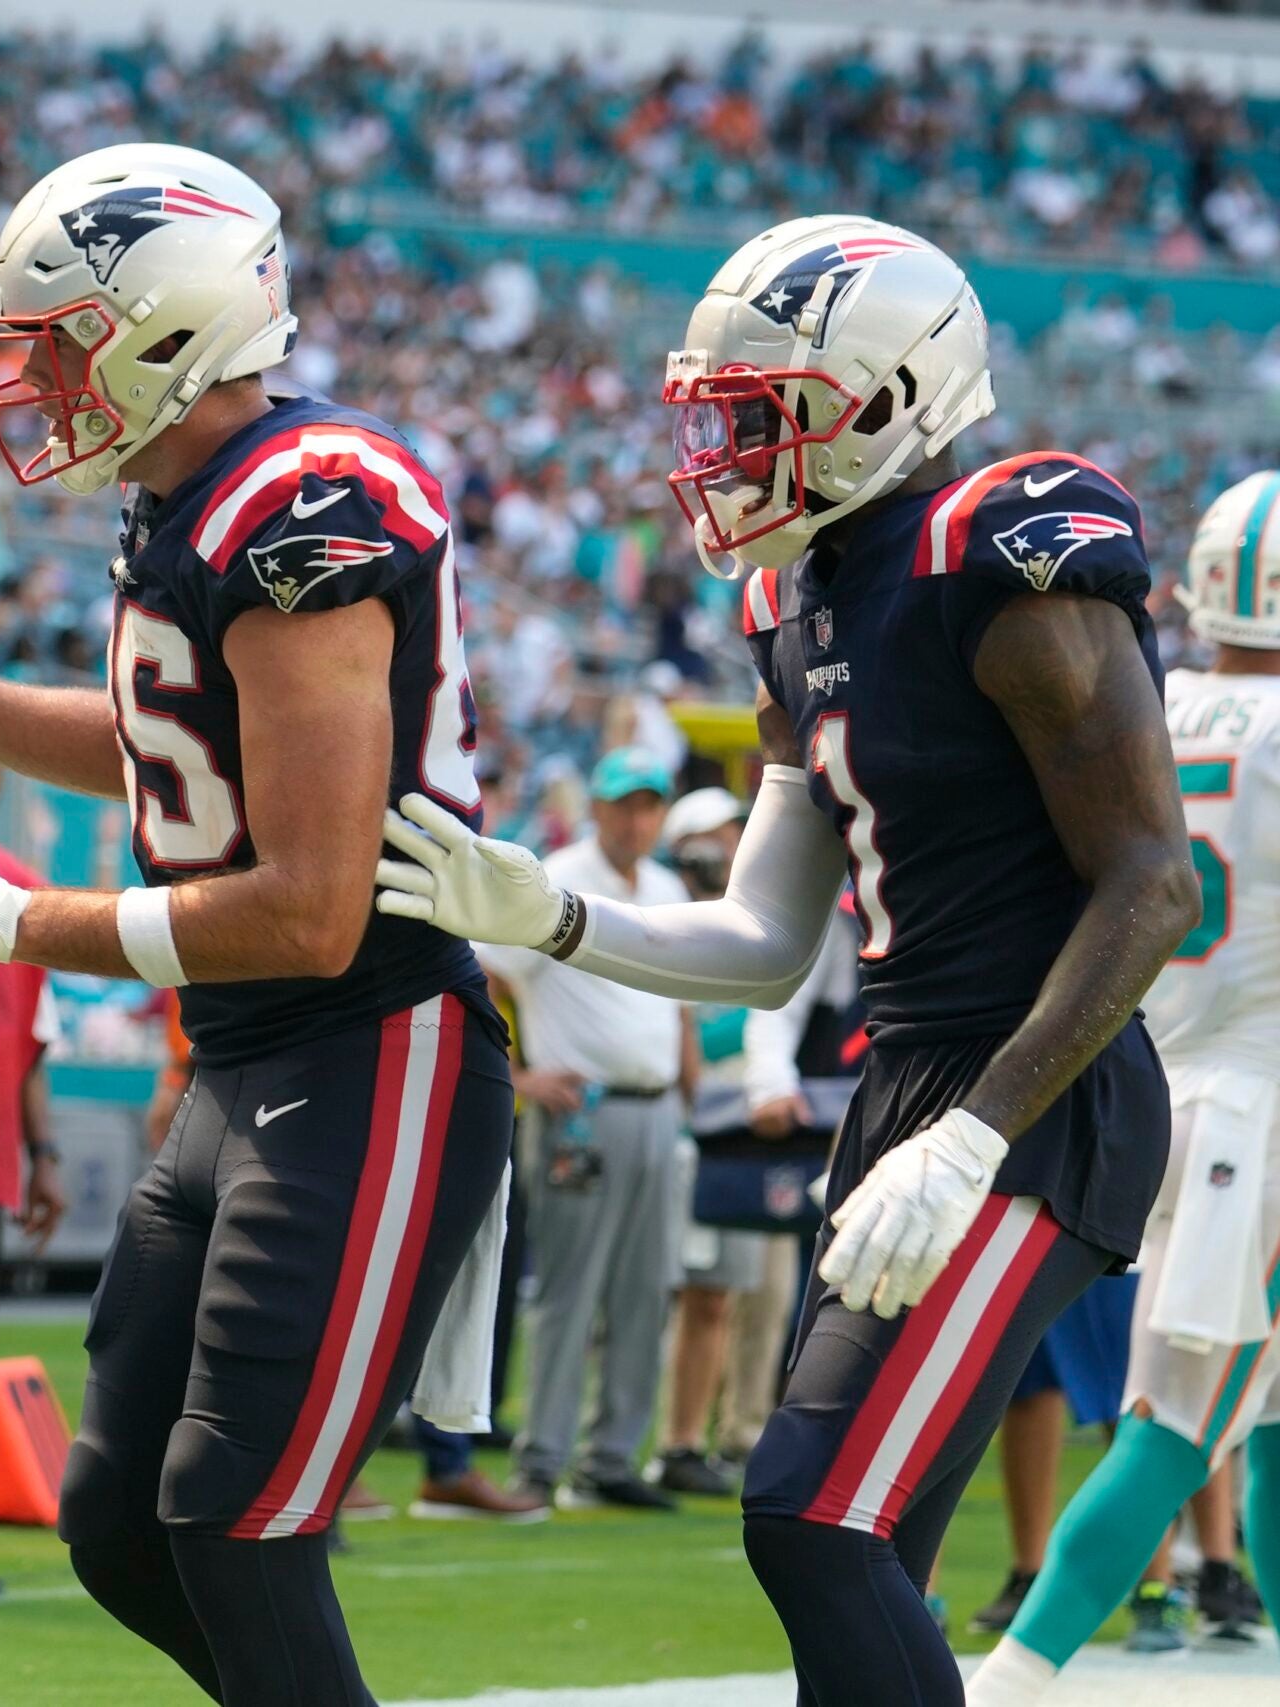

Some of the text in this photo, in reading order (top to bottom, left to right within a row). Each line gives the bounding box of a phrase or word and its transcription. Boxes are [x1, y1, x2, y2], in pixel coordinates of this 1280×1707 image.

[107, 599, 249, 869] 5
[812, 710, 897, 958] 1
[551, 900, 577, 944] NEVER
